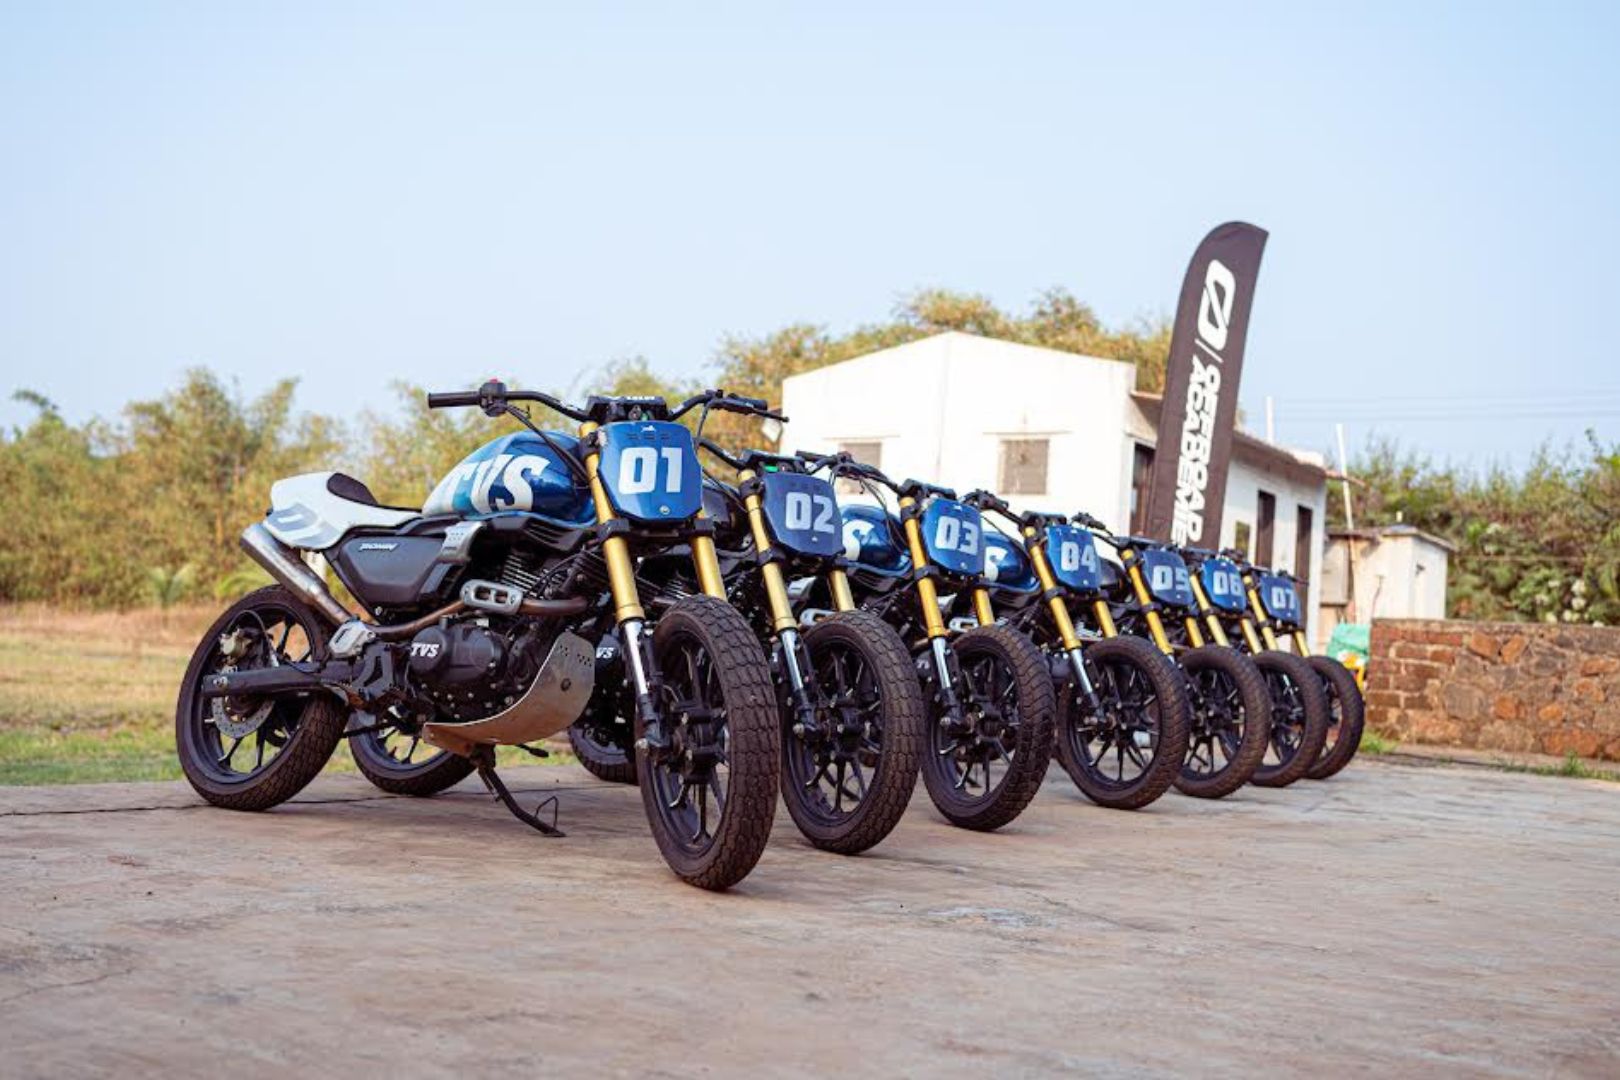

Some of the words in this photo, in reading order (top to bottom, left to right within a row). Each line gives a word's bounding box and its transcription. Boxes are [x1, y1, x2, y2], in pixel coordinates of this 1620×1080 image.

[617, 446, 683, 495] 01
[785, 491, 835, 534] 02
[934, 515, 980, 556] 03
[1060, 541, 1097, 574] 04
[1152, 564, 1192, 593] 05
[1212, 570, 1242, 597] 06
[1270, 585, 1296, 611] 07
[411, 642, 440, 659] TVS
[595, 647, 615, 659] VS
